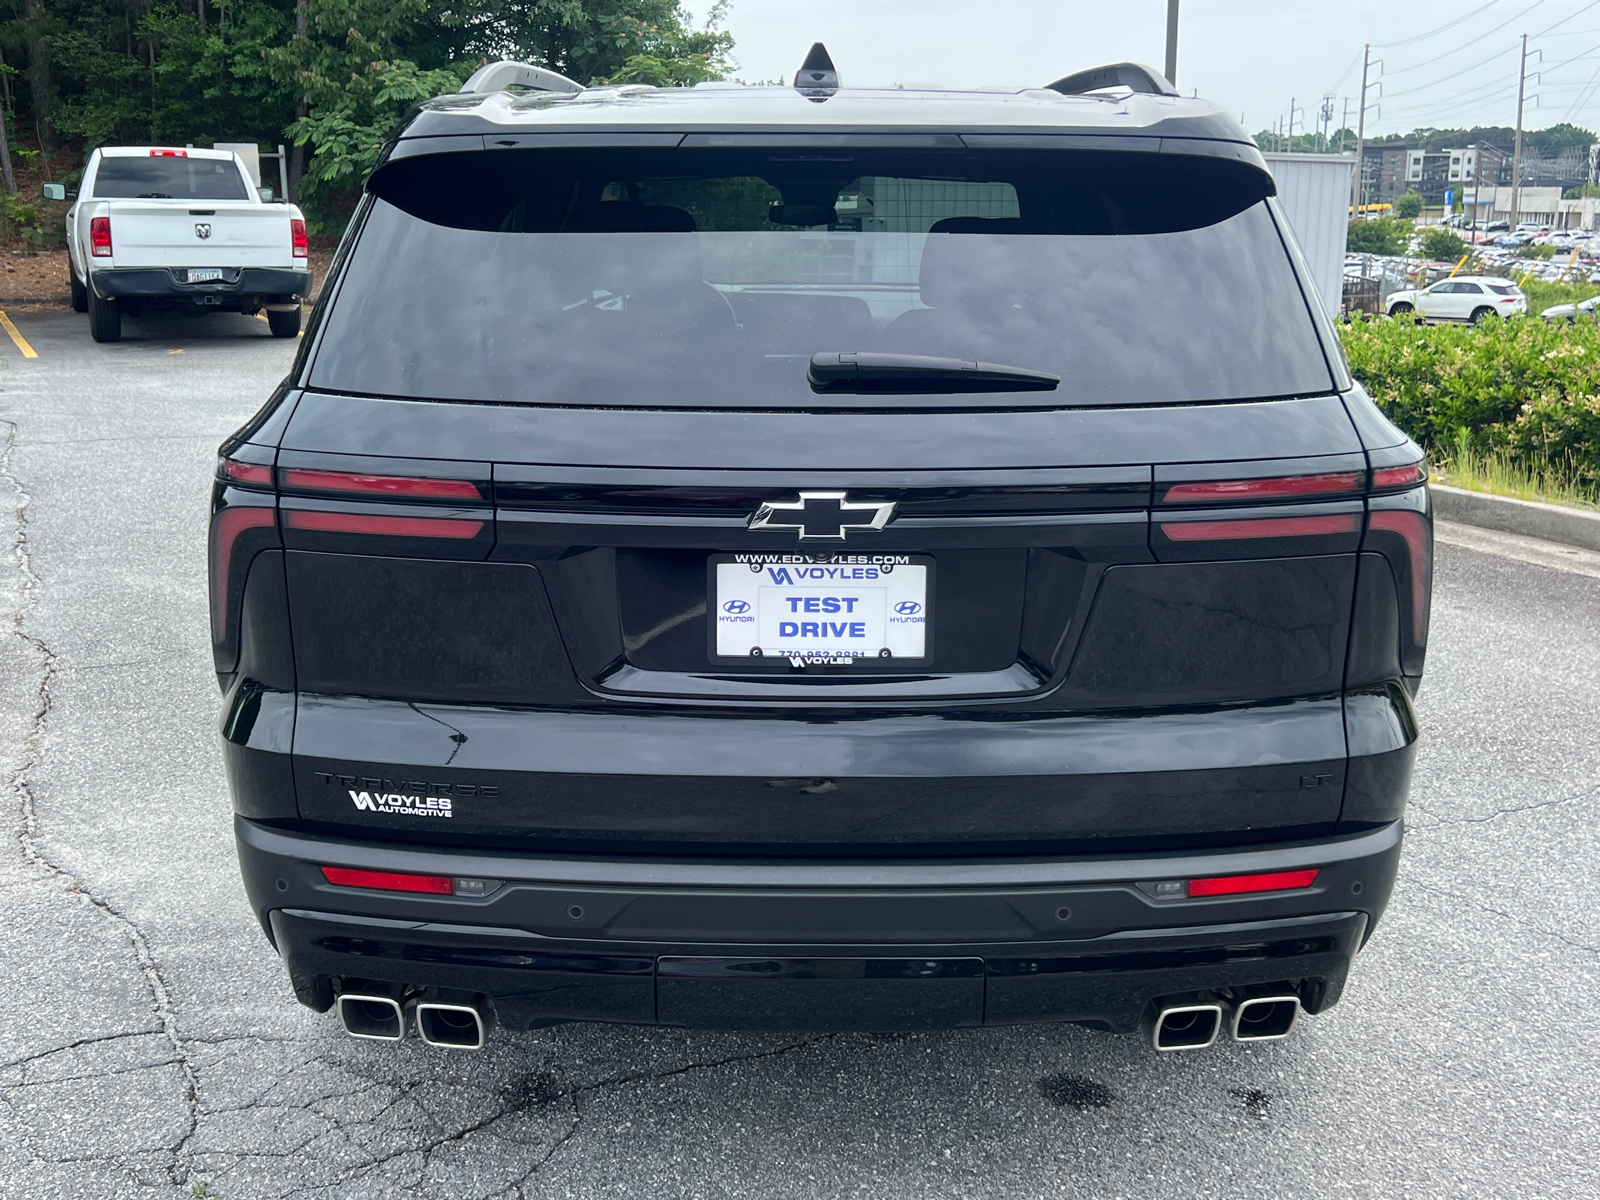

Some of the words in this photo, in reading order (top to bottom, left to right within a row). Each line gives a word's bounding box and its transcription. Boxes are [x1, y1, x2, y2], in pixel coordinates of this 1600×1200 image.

[735, 554, 910, 565] WWW.EDVYLES.COM
[794, 567, 879, 580] VOYLES
[785, 597, 859, 614] TEST
[889, 616, 926, 624] HYUNDAI
[779, 622, 866, 638] DRIVE
[804, 656, 853, 665] VOYLES
[314, 771, 499, 798] TRAVERSE
[374, 792, 452, 810] VOYLES
[377, 806, 453, 818] AUTOMOTIVE
